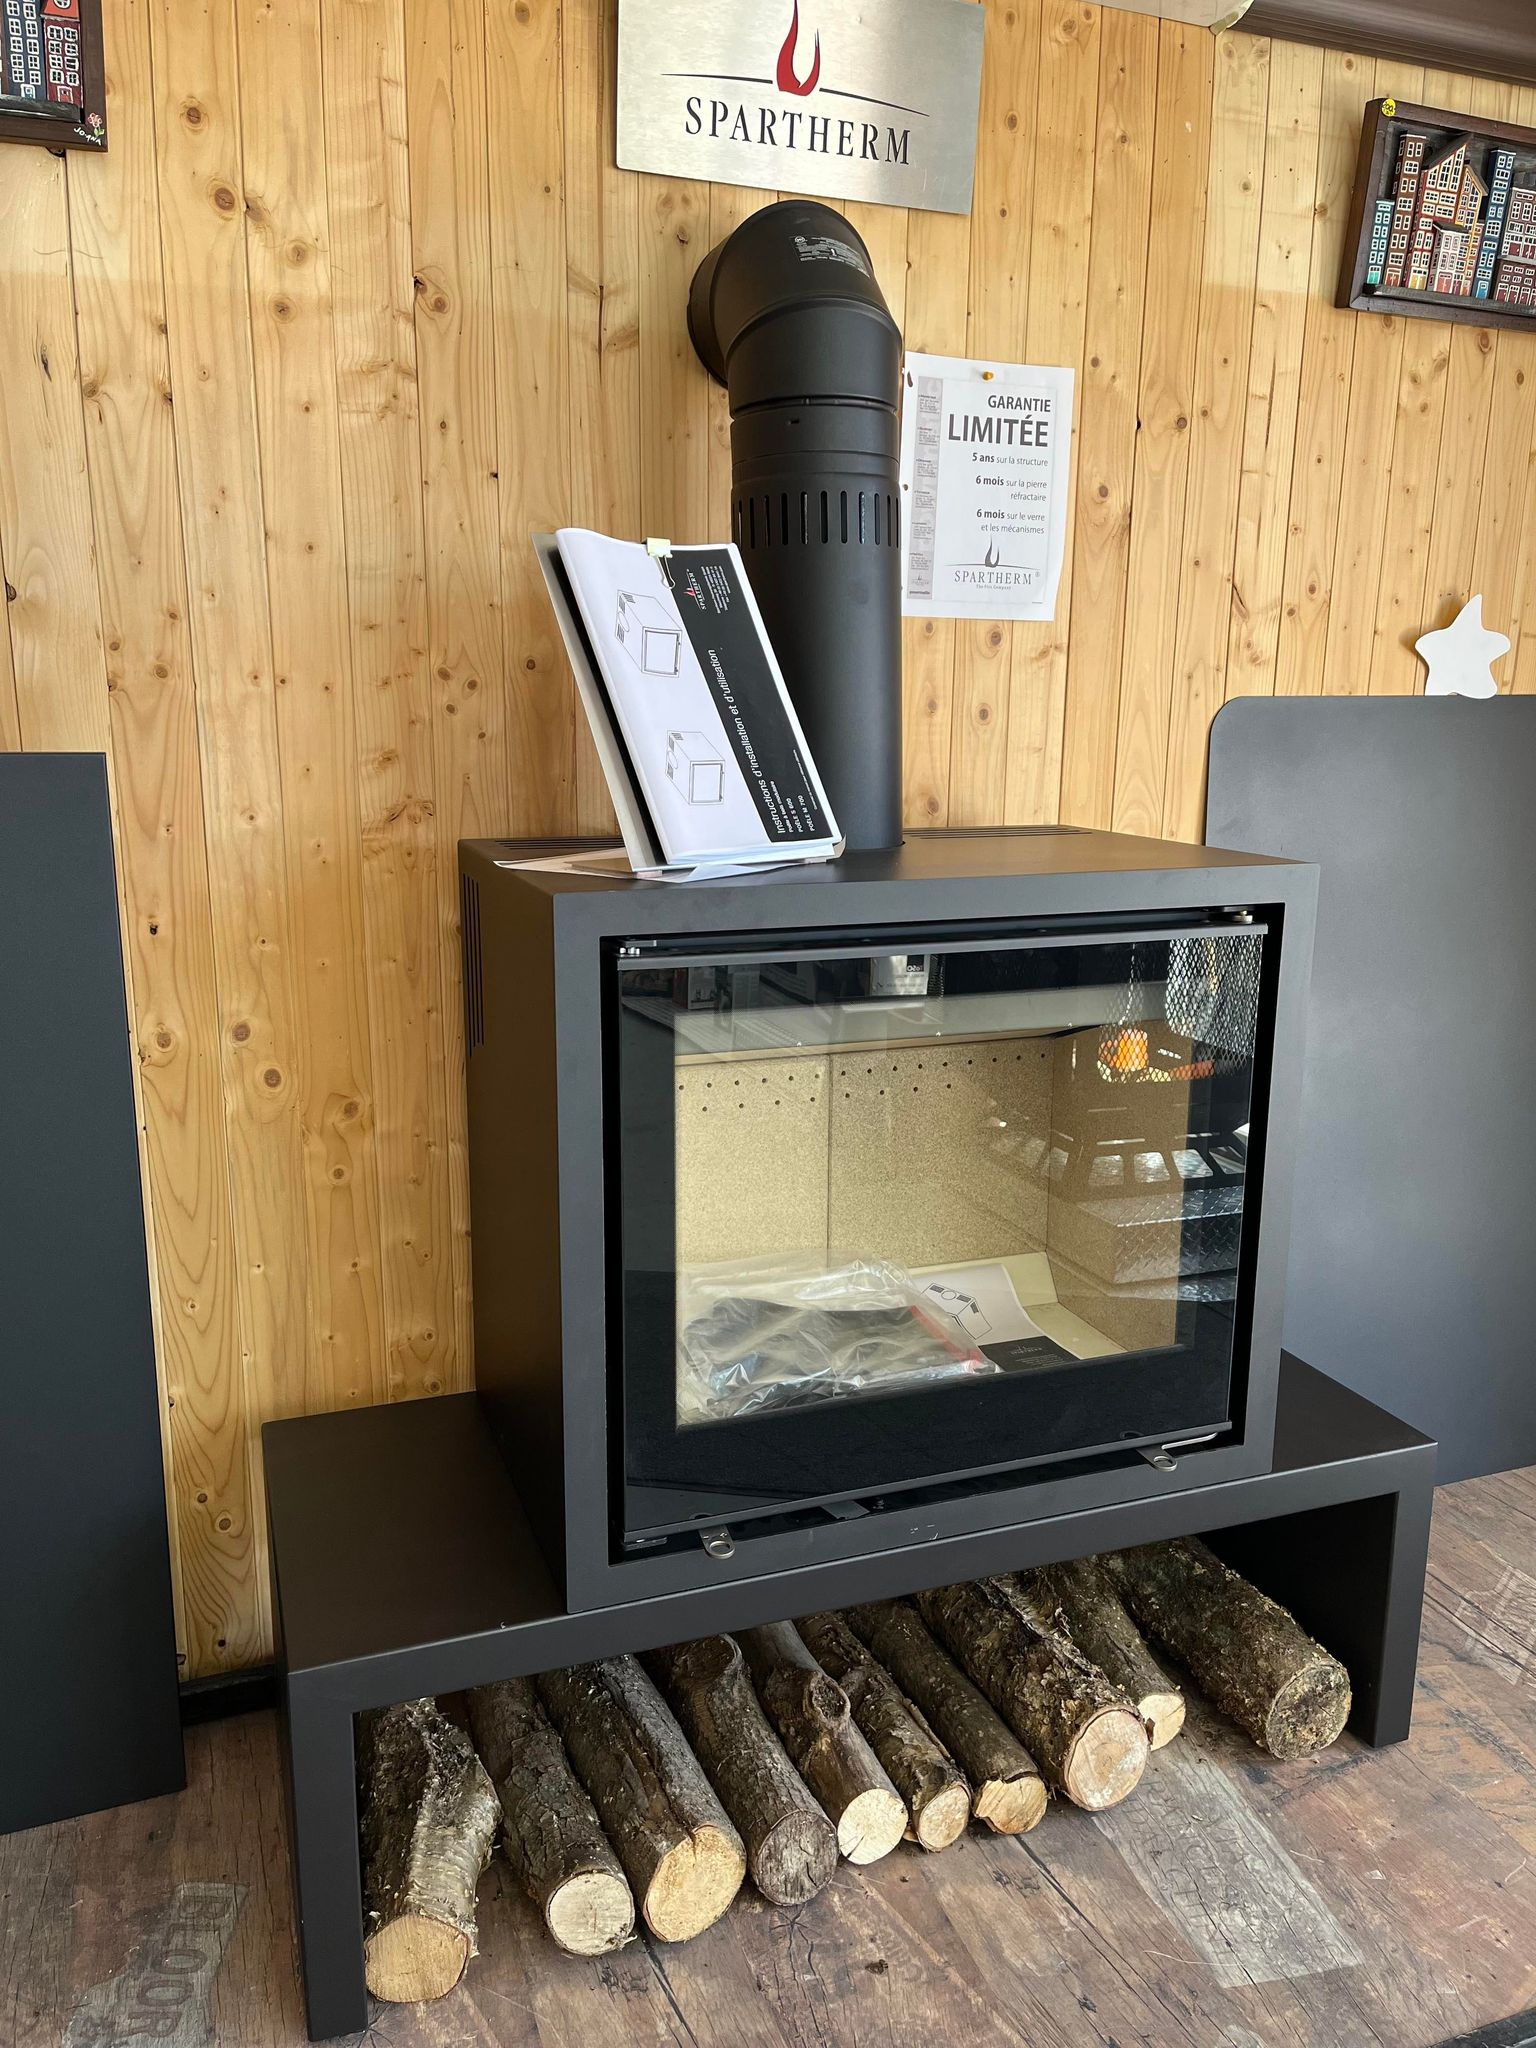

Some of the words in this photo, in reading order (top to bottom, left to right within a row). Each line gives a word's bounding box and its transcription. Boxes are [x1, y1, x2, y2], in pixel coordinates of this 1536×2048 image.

[685, 96, 911, 165] SPARTHERM
[988, 395, 1051, 412] GARANTIE
[948, 413, 1049, 448] LIMITÉE
[972, 452, 978, 462] 5
[980, 454, 995, 463] ans
[996, 456, 1007, 464] sur
[1008, 456, 1015, 465] la
[1016, 457, 1049, 467] structure
[975, 475, 982, 485] 6
[983, 476, 1004, 486] mois
[1006, 479, 1017, 487] sur
[1018, 479, 1025, 488] la
[1026, 480, 1048, 489] pierre
[1010, 491, 1047, 502] réfractaire
[976, 508, 982, 518] 6
[983, 509, 1005, 519] mois
[1006, 512, 1018, 520] sur
[1019, 511, 1026, 521] le
[980, 524, 988, 532] et
[989, 523, 999, 532] les
[1000, 525, 1045, 534] mécanismes
[708, 649, 735, 703] d'utilisation
[728, 705, 739, 715] et
[734, 717, 763, 778] d'installation
[758, 779, 786, 834] Instructions
[797, 795, 806, 806] 700
